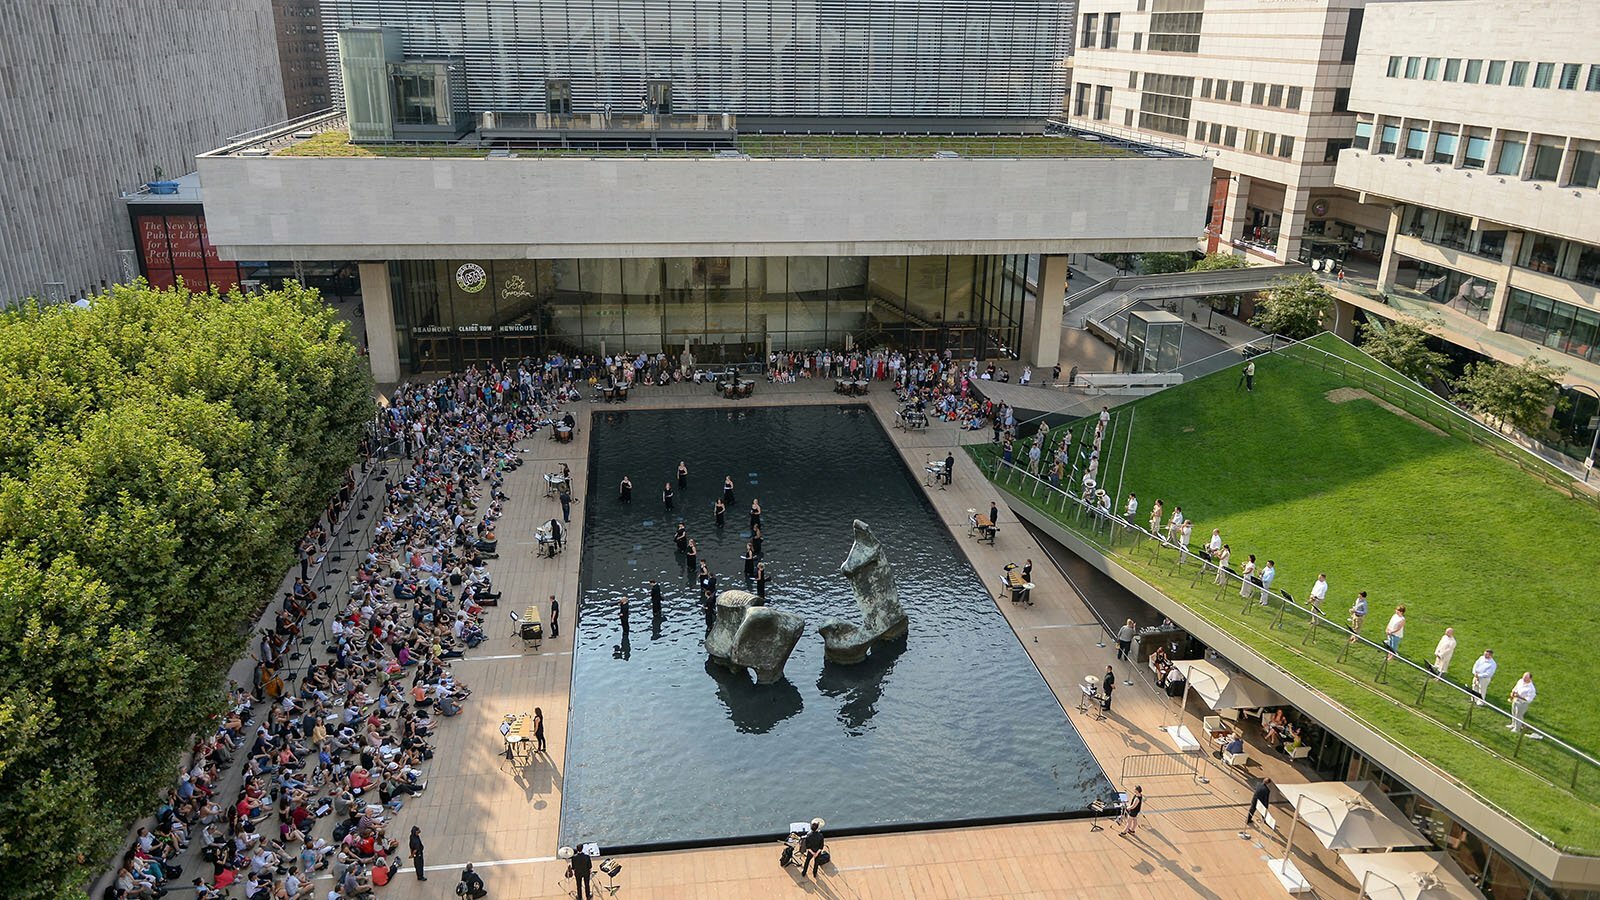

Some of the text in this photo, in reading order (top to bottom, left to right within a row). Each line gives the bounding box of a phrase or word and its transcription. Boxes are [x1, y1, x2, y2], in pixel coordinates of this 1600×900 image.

[144, 222, 161, 230] The
[166, 222, 184, 230] New
[146, 231, 176, 239] Public
[147, 241, 161, 250] for
